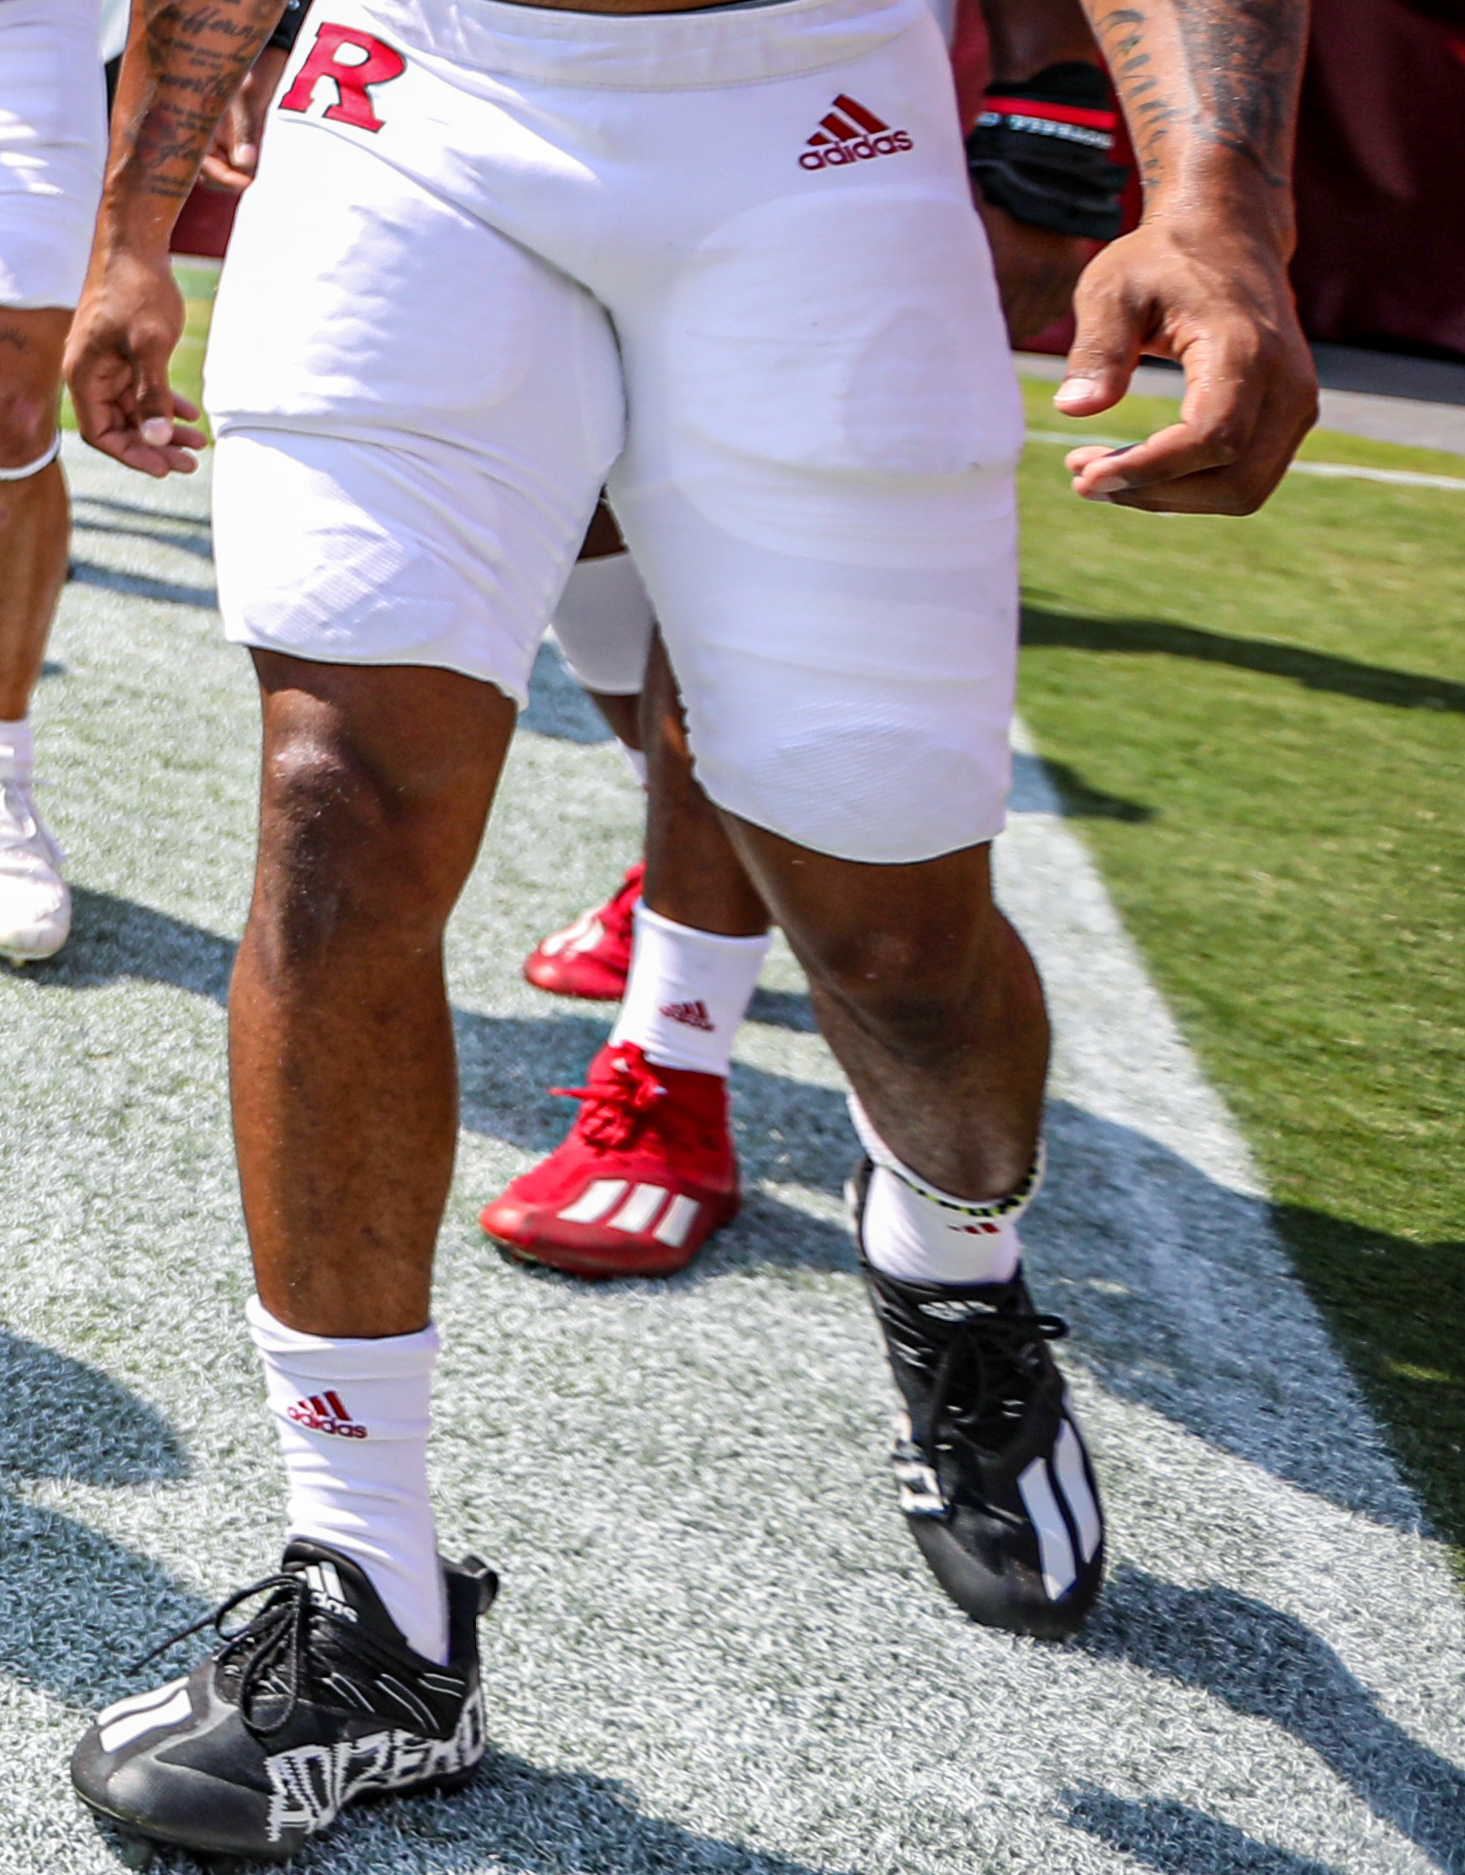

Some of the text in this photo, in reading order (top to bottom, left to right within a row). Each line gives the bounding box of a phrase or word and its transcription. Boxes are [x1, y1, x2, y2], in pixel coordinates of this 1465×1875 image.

[278, 20, 406, 134] R
[799, 125, 915, 173] adidas
[286, 1405, 368, 1440] adidas
